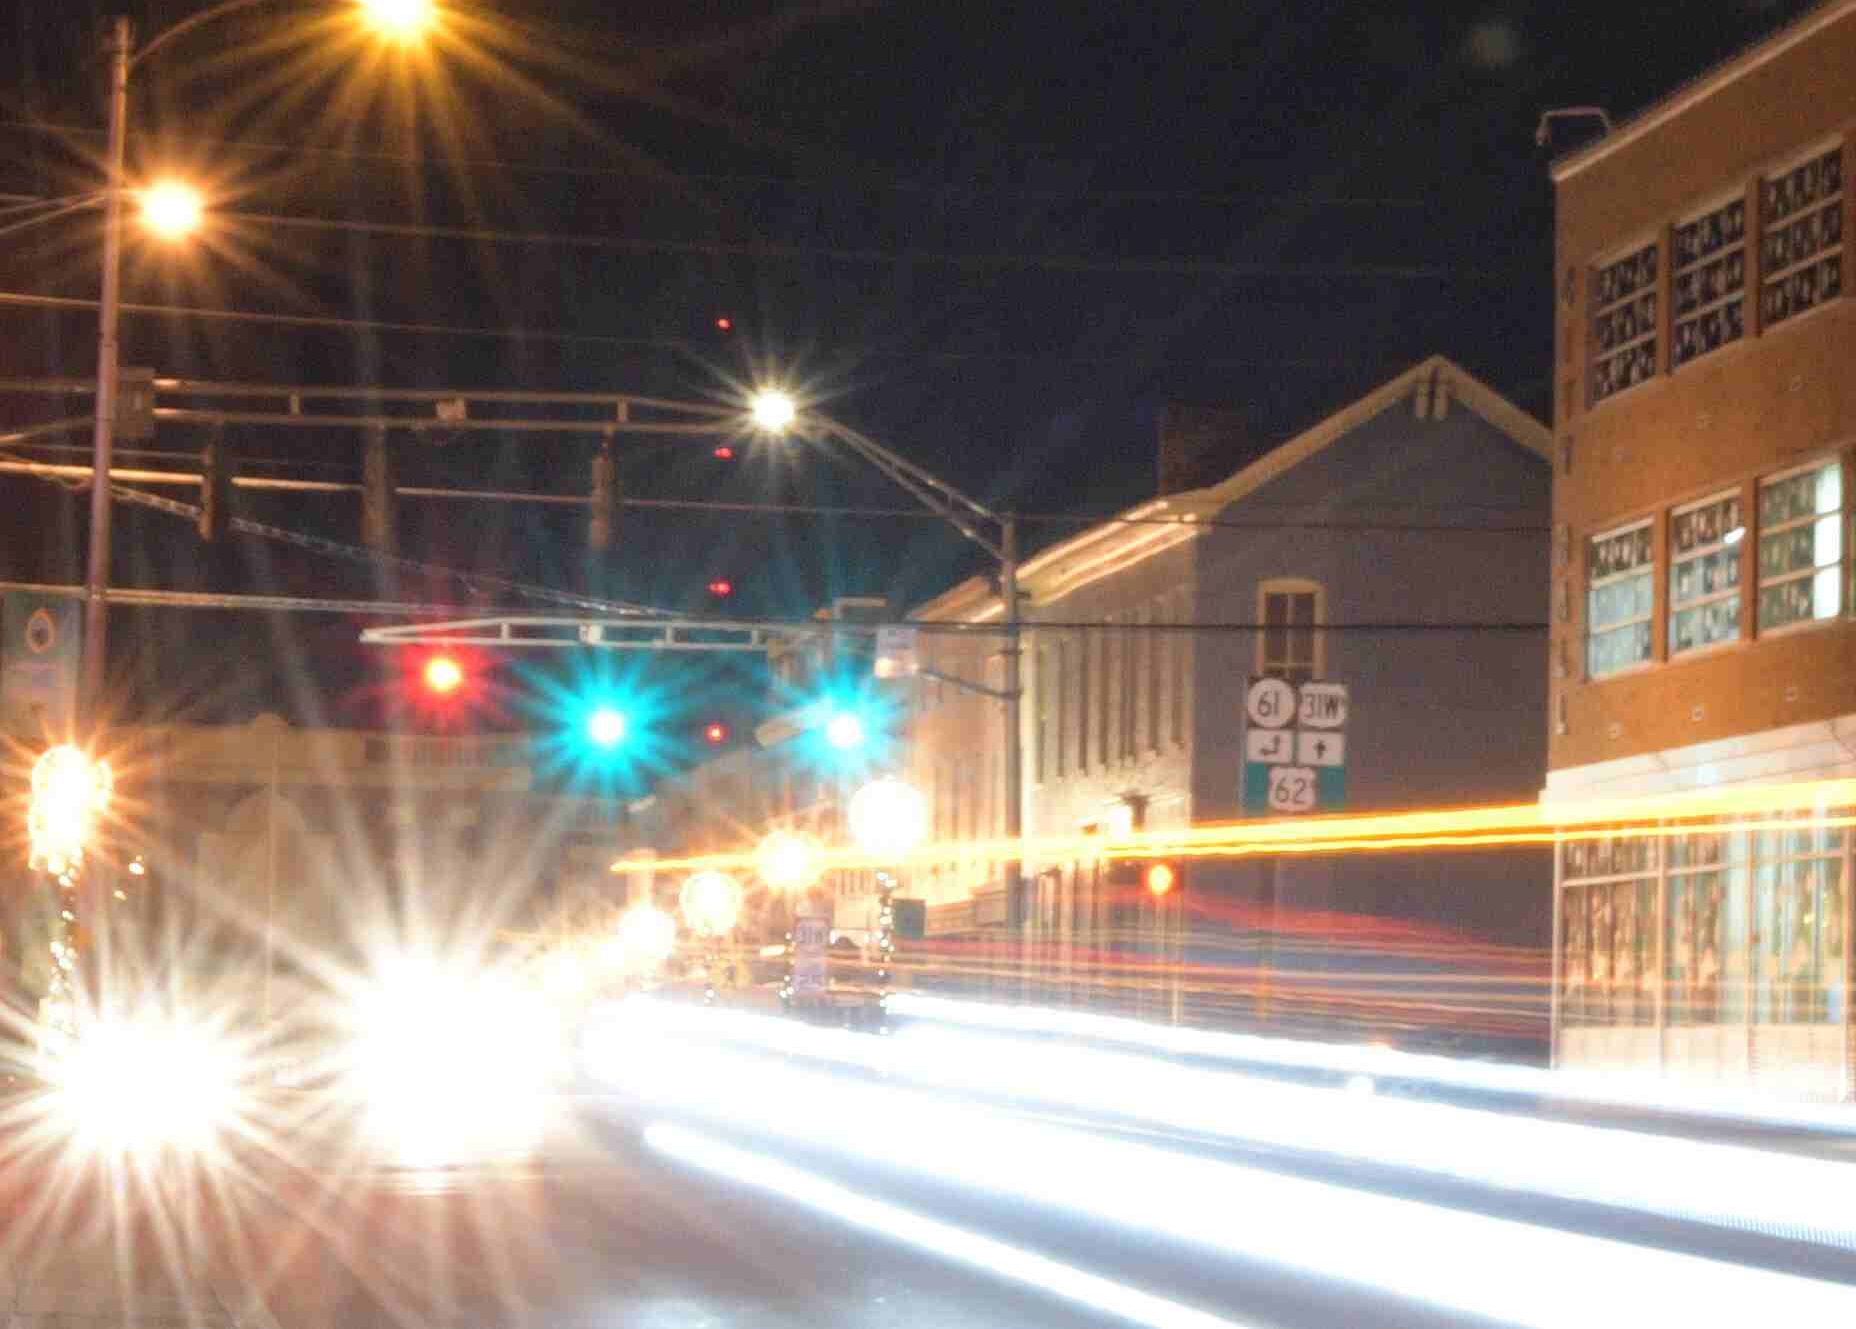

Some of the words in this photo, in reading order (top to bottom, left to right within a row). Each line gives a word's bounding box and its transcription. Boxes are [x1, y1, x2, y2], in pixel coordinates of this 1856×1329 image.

[1257, 691, 1279, 717] 61
[1302, 693, 1339, 718] 31W
[1275, 776, 1306, 804] 62
